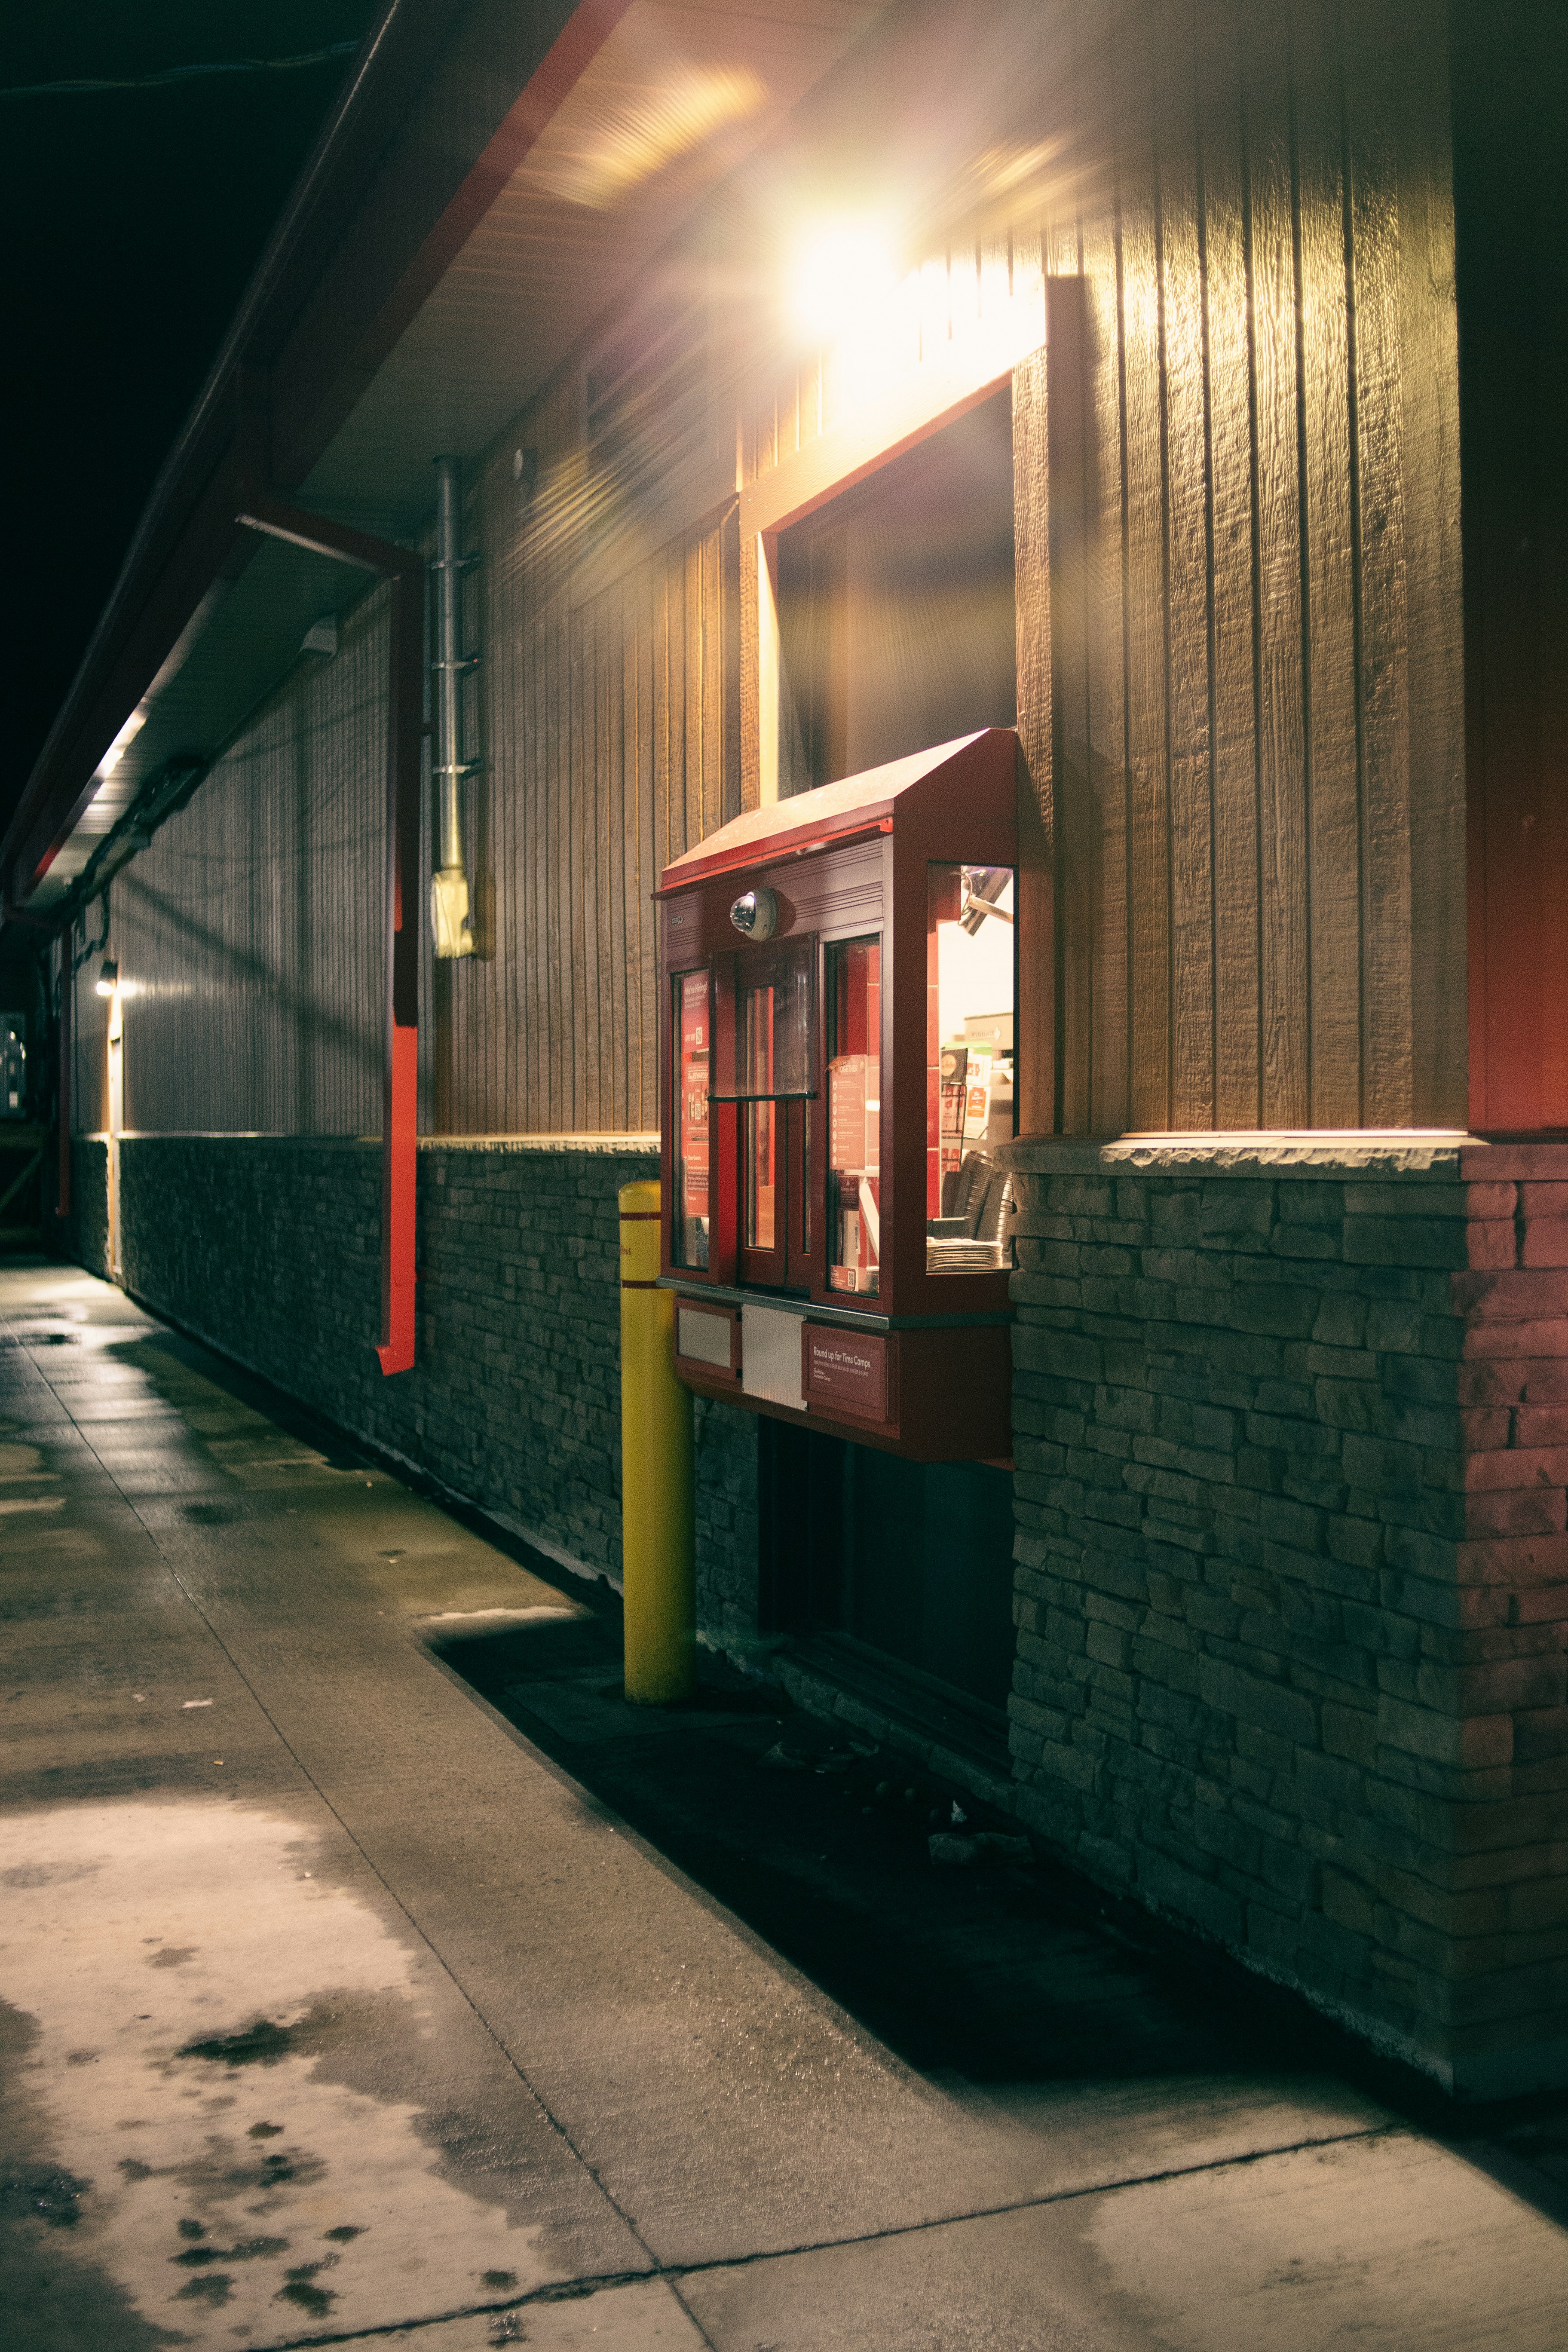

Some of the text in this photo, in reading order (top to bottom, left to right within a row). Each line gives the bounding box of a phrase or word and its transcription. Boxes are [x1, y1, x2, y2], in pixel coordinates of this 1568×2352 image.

[838, 1064, 858, 1073] TOGETHER
[814, 1346, 827, 1358] Round
[828, 1352, 834, 1362] up
[842, 1352, 853, 1364] Tims
[854, 1355, 870, 1370] Camps
